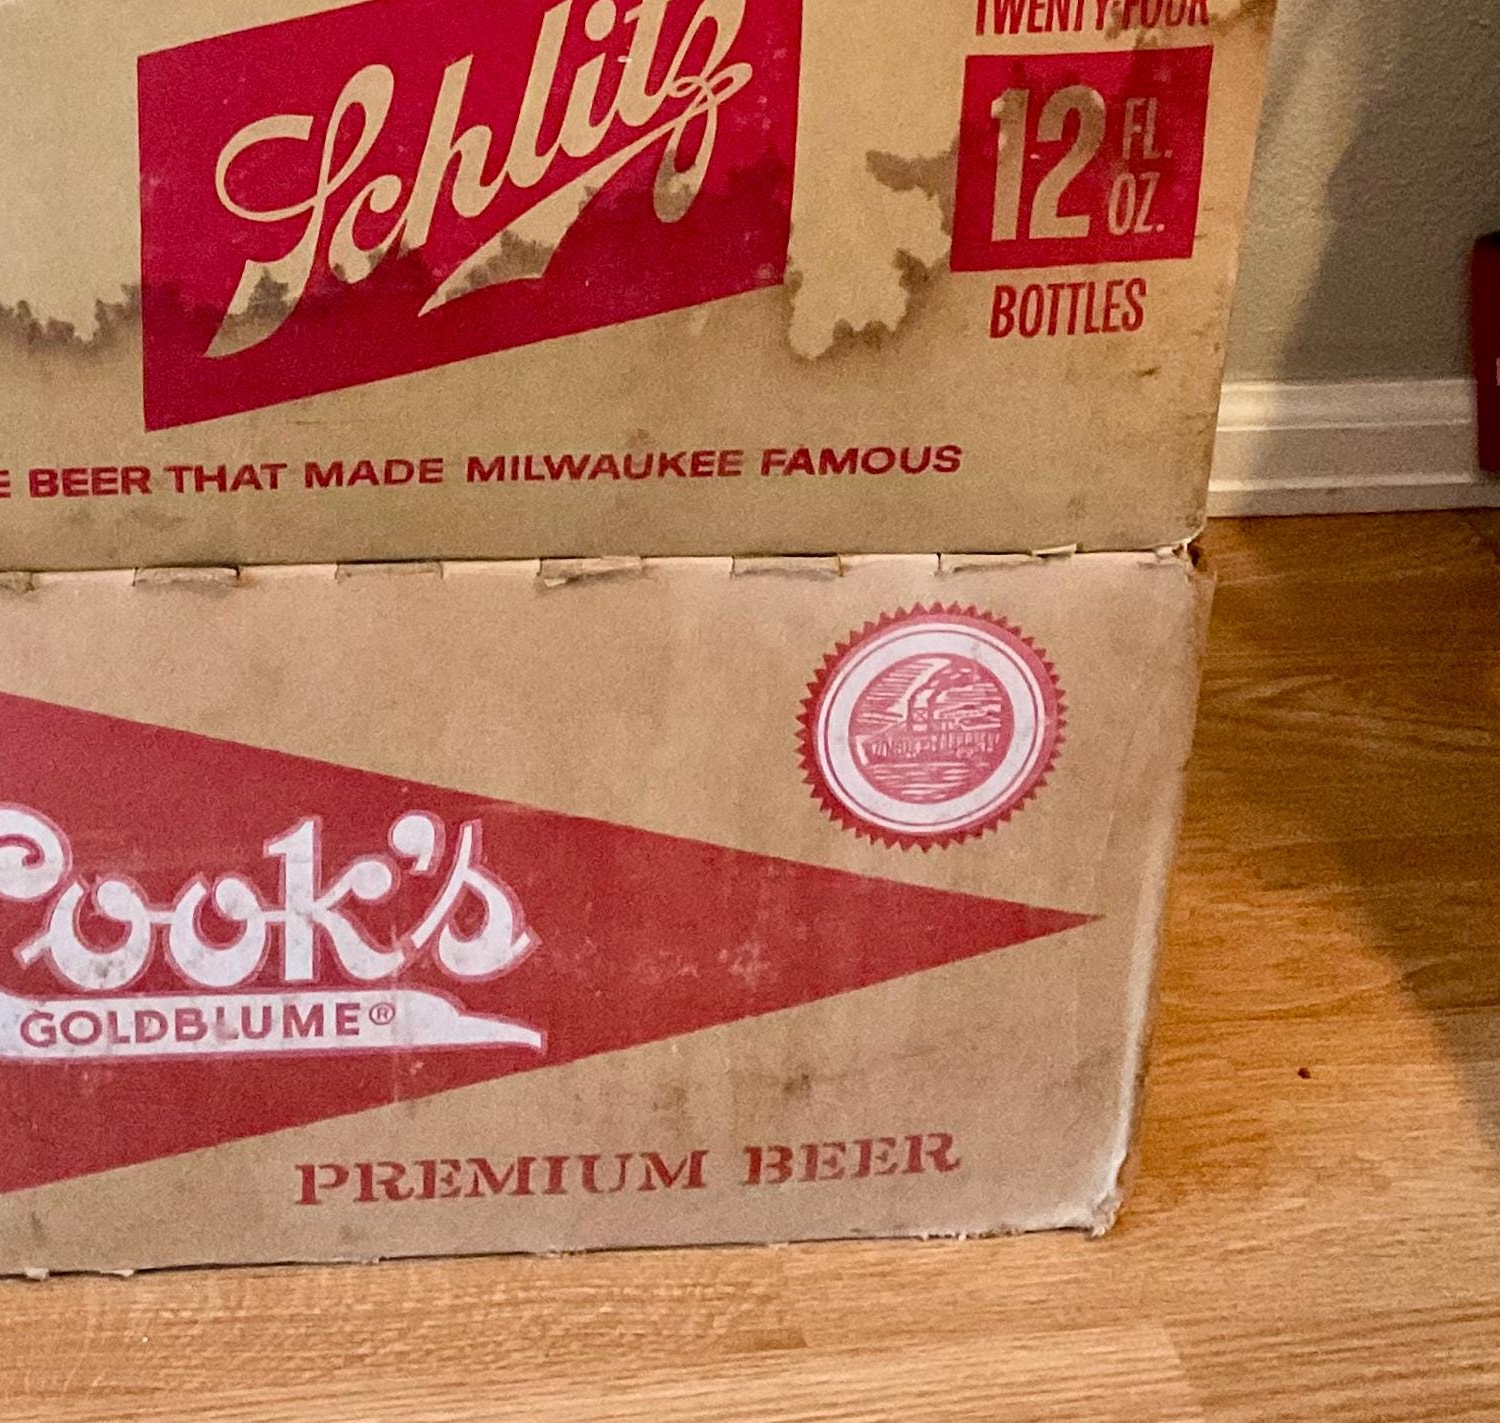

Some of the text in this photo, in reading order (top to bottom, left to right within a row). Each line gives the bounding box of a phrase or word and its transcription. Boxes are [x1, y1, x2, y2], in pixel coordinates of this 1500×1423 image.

[1121, 95, 1173, 161] FL.
[990, 84, 1106, 242] 12
[1107, 171, 1165, 236] OZ.
[989, 277, 1147, 338] BOTTLES
[27, 463, 152, 499] BEER
[164, 458, 287, 495] THAT
[303, 455, 444, 489] MADE
[464, 447, 743, 484] MILWAUKEE
[761, 443, 963, 478] FAMOUS
[295, 1129, 962, 1208] PREMIUM BEER
